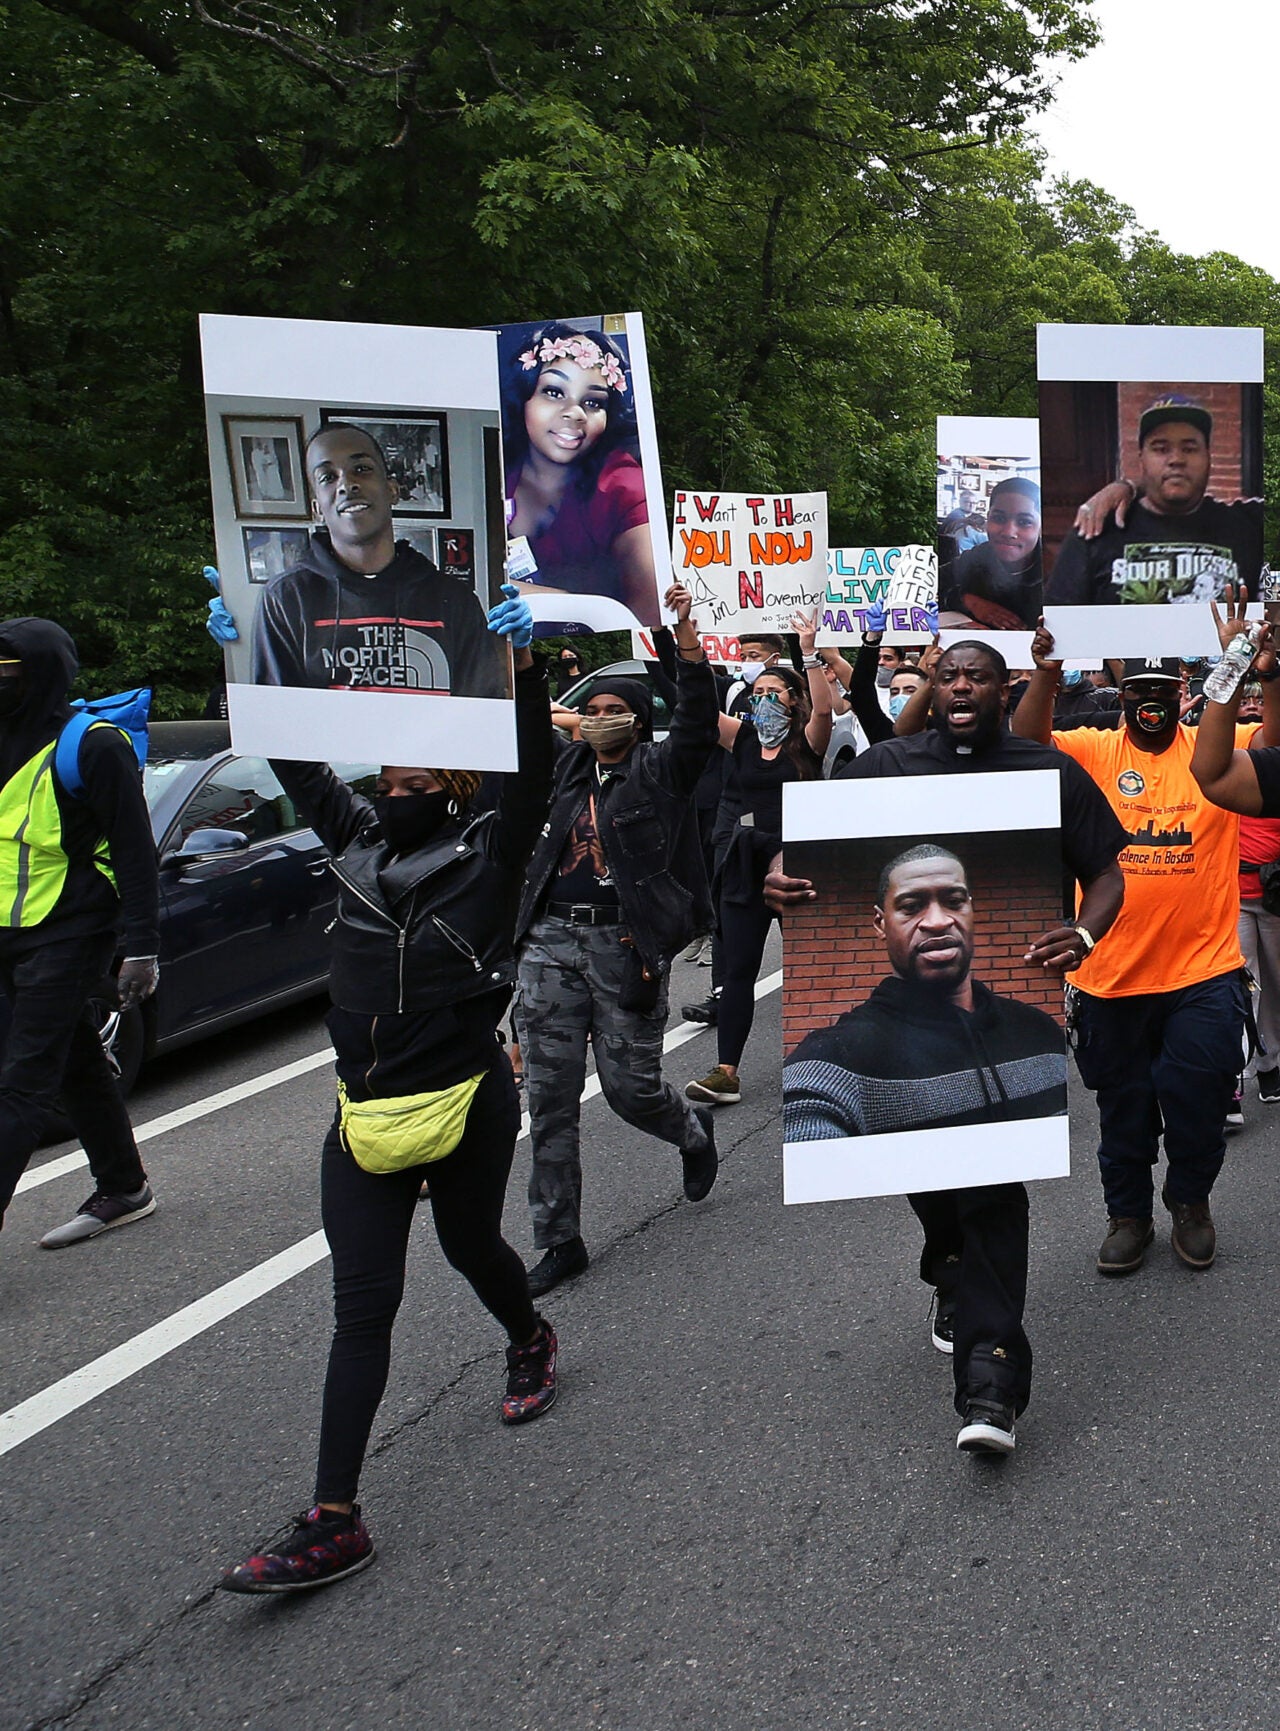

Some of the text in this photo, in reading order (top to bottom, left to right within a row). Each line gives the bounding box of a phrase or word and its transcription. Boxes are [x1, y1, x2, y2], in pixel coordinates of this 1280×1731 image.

[675, 493, 819, 527] I Want To Hear
[679, 528, 812, 568] YOU NOW
[902, 548, 937, 571] ACK
[827, 548, 902, 576] LAC
[900, 564, 936, 588] VES
[738, 571, 825, 609] November
[826, 579, 891, 603] LIV
[815, 606, 929, 632] MATER
[357, 626, 404, 646] THE
[322, 646, 405, 669] NORTH
[349, 666, 405, 686] FACE
[1118, 849, 1195, 864] iolence In Boston
